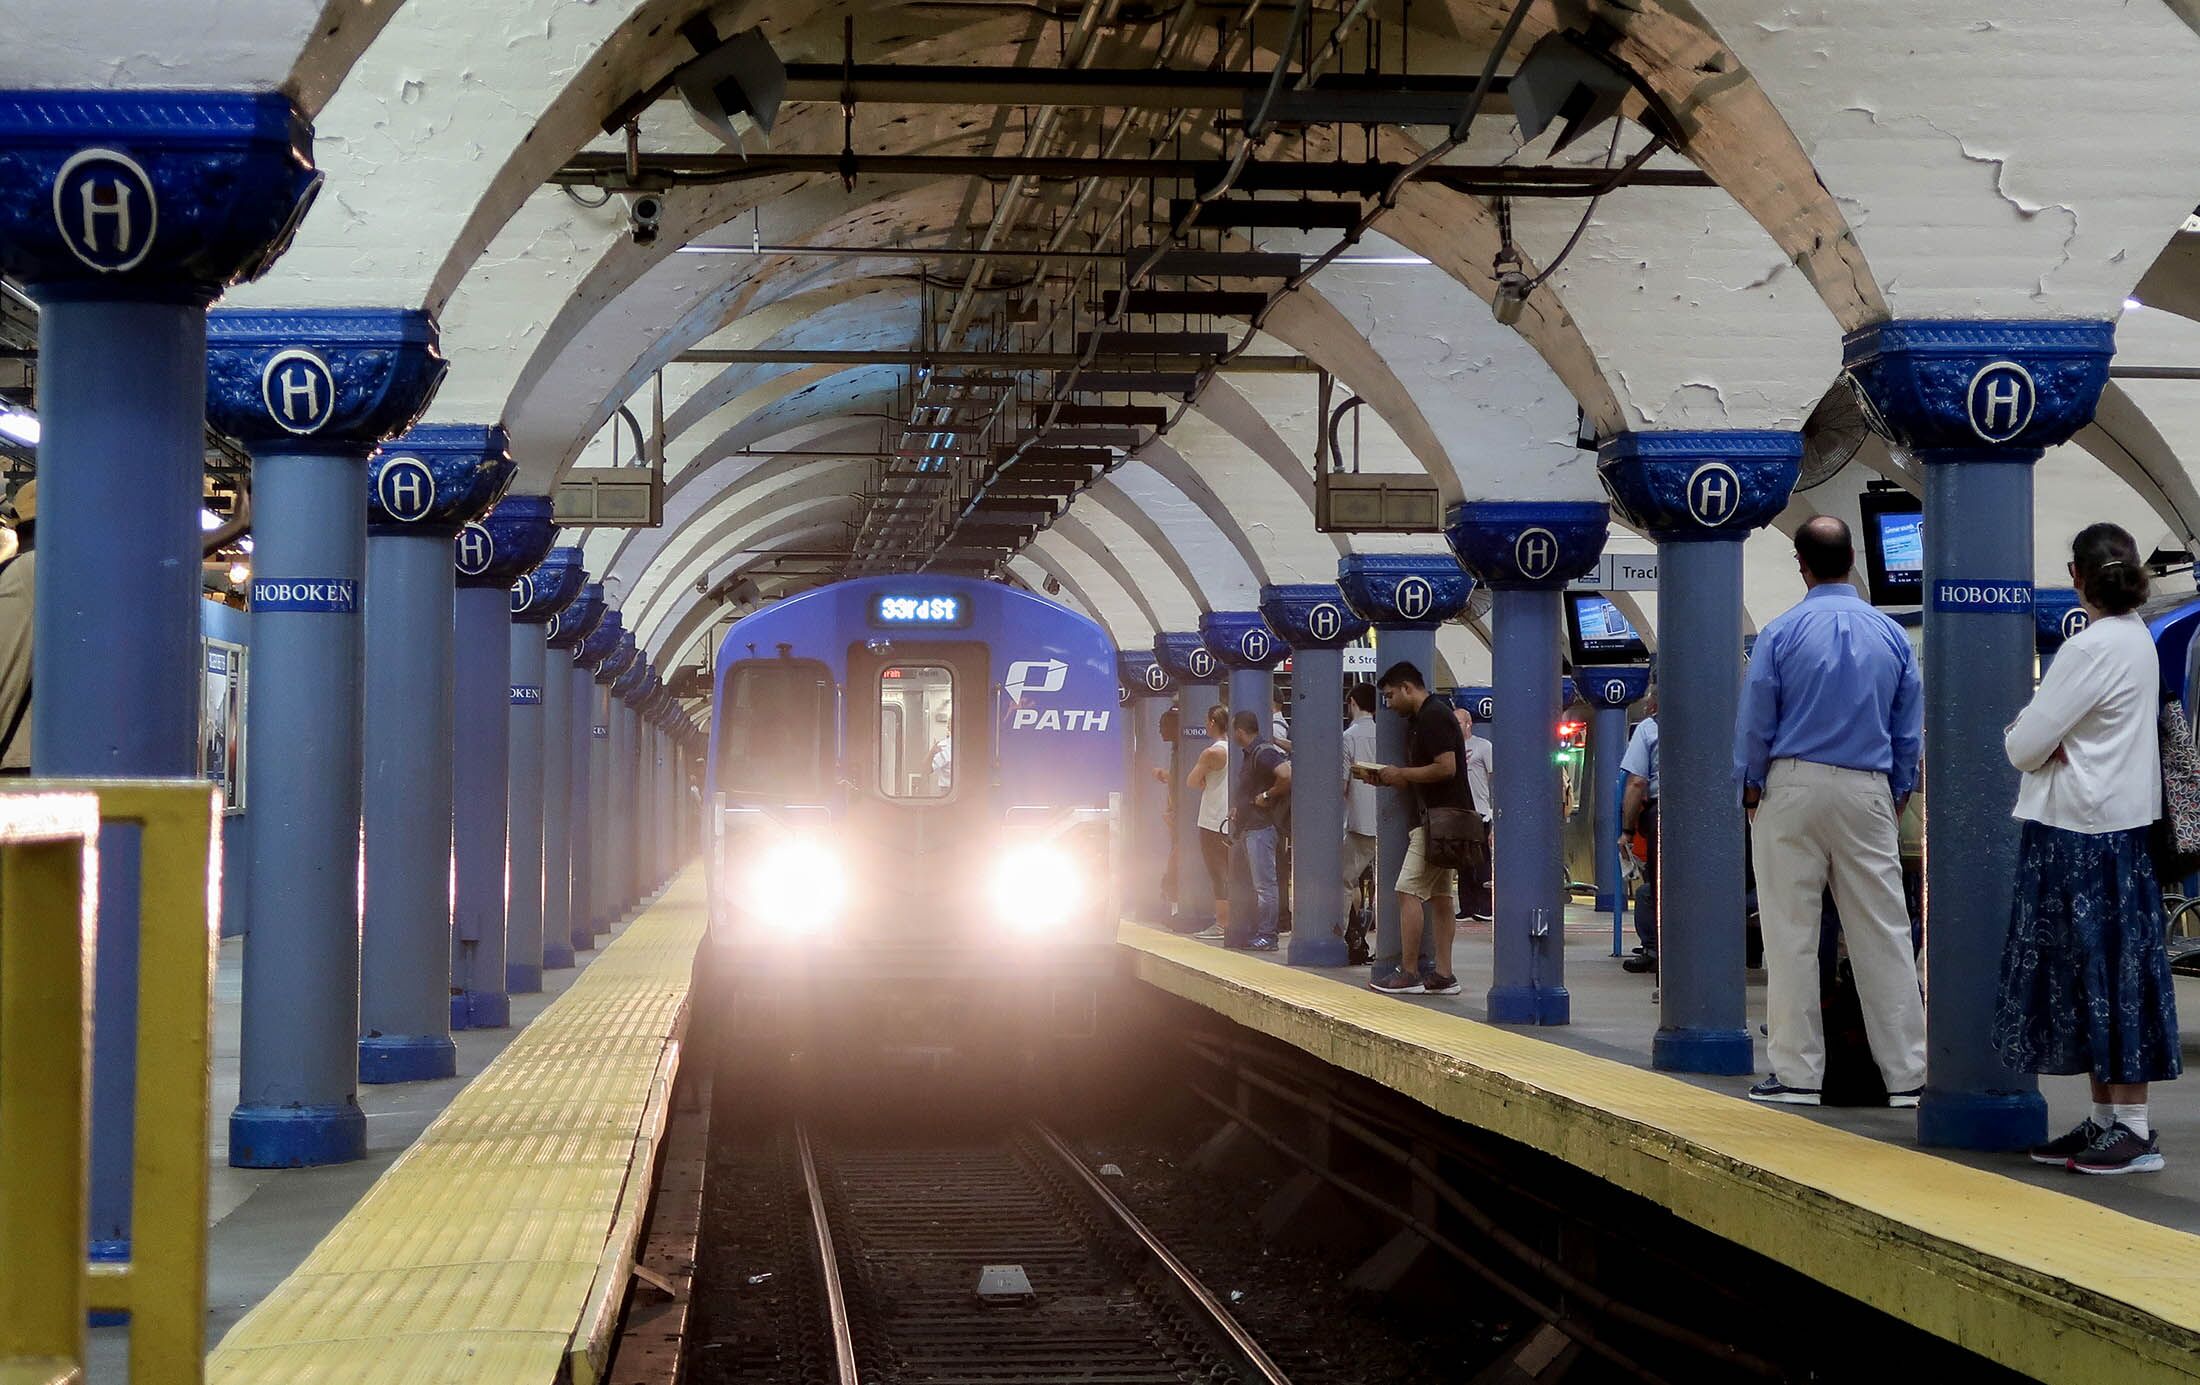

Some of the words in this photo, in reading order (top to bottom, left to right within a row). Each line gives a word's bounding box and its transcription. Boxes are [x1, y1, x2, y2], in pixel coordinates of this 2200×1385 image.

[80, 179, 132, 252] H
[280, 368, 319, 420] H
[1985, 379, 2021, 428] H
[391, 471, 423, 511] H
[1700, 476, 1728, 516] H
[459, 533, 484, 565] H
[1526, 538, 1549, 570] H
[255, 583, 351, 602] HOBOKEN
[1405, 586, 1424, 613] H
[1941, 585, 2032, 604] HOBOKEN
[881, 598, 929, 619] 33rd
[930, 598, 956, 619] St
[1318, 611, 1334, 635] H
[1249, 636, 1263, 656] H
[1196, 653, 1209, 673] H
[1151, 669, 1164, 687] H
[1012, 709, 1111, 731] PATH
